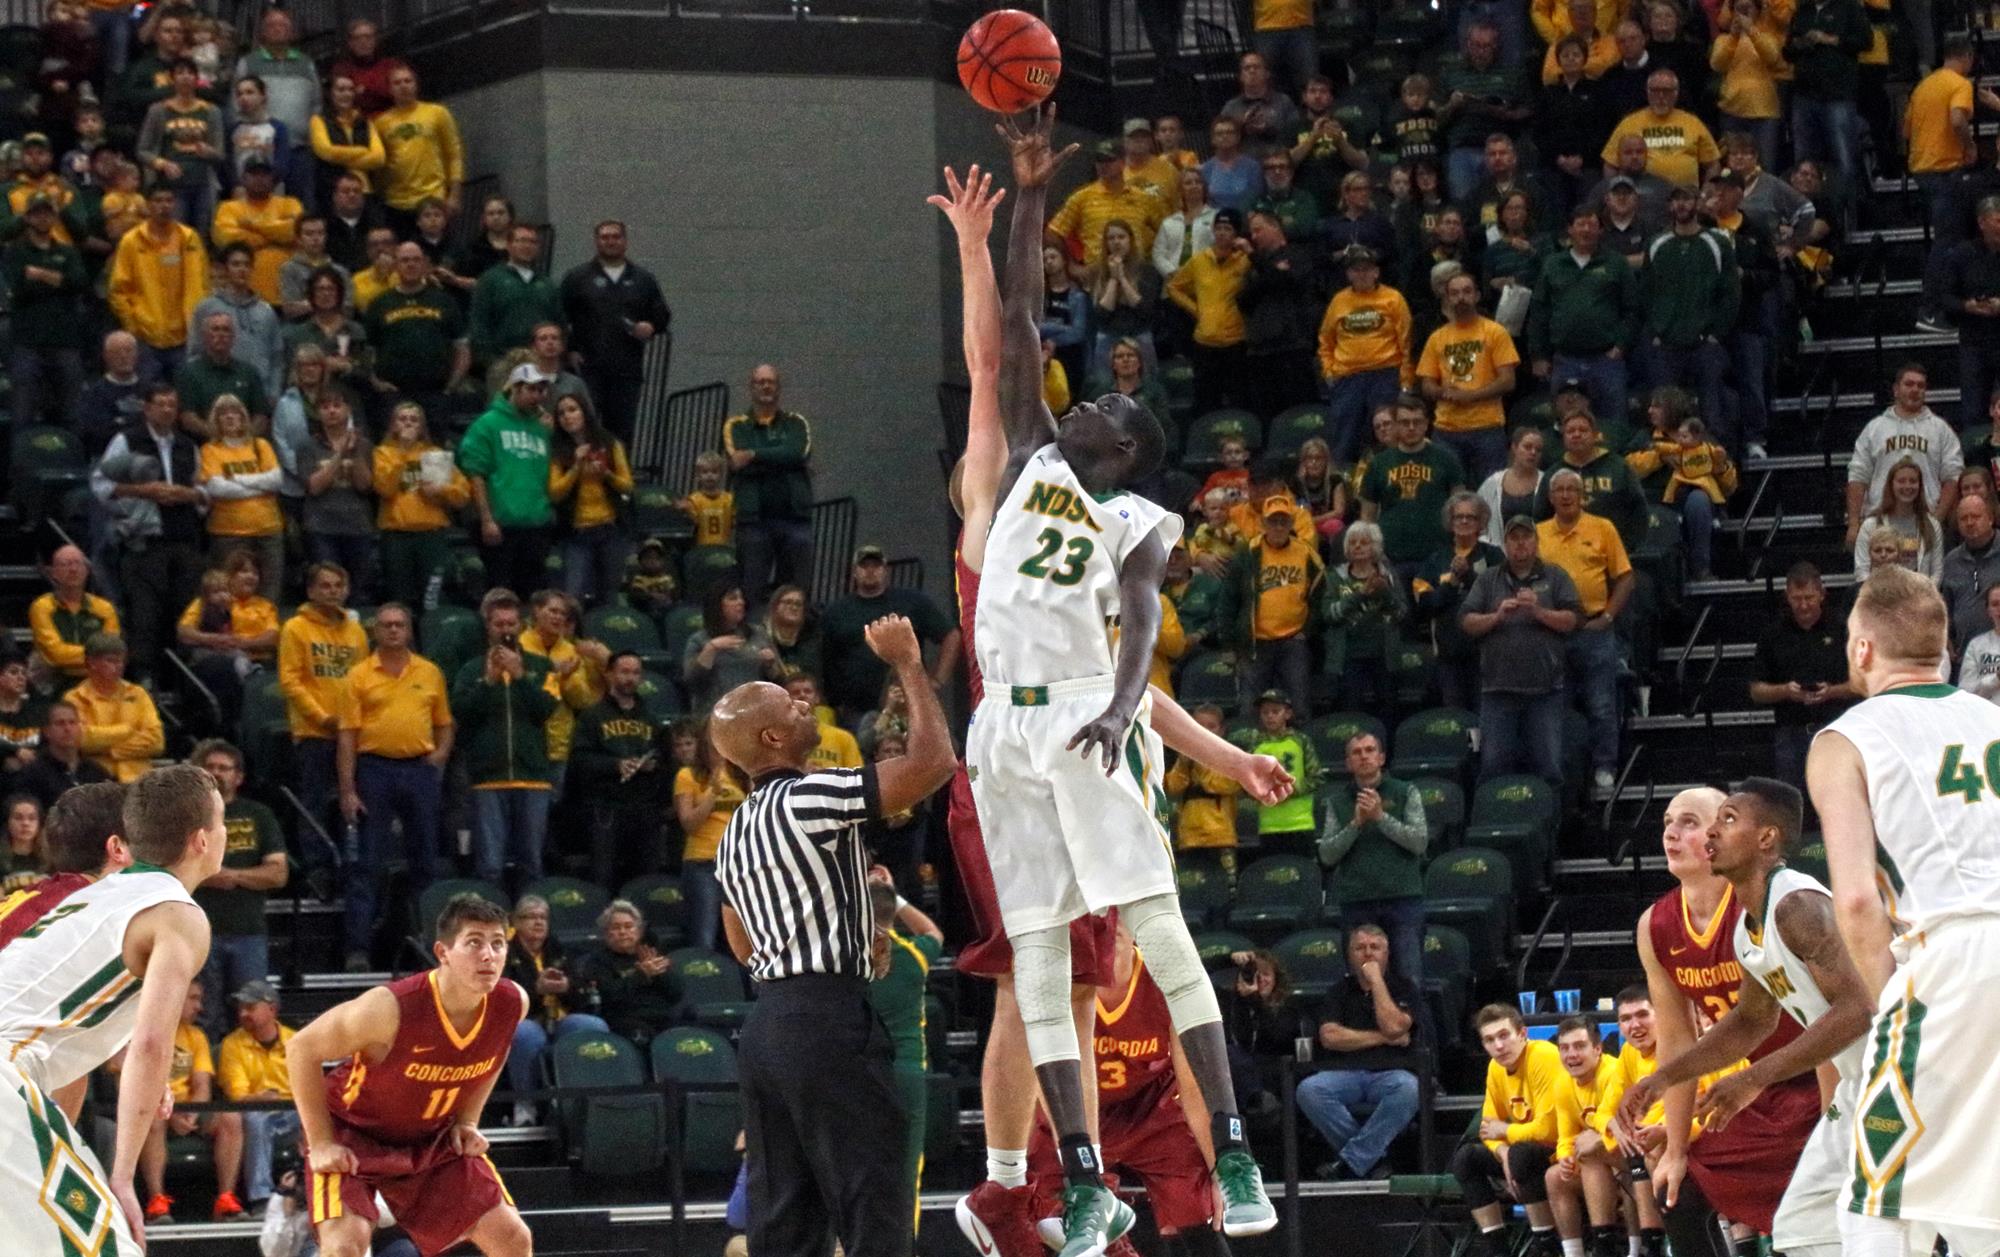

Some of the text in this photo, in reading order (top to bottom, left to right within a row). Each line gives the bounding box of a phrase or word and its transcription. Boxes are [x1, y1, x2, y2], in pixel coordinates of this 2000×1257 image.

[1885, 434, 1929, 455] NDSU
[1388, 464, 1431, 486] NDSU
[1018, 527, 1095, 587] 23
[602, 719, 653, 741] NDSU
[1675, 960, 1744, 988] CONCORDI
[1094, 1036, 1159, 1058] CORDIA
[405, 1056, 496, 1082] CONCORDIA
[422, 1086, 461, 1120] 11
